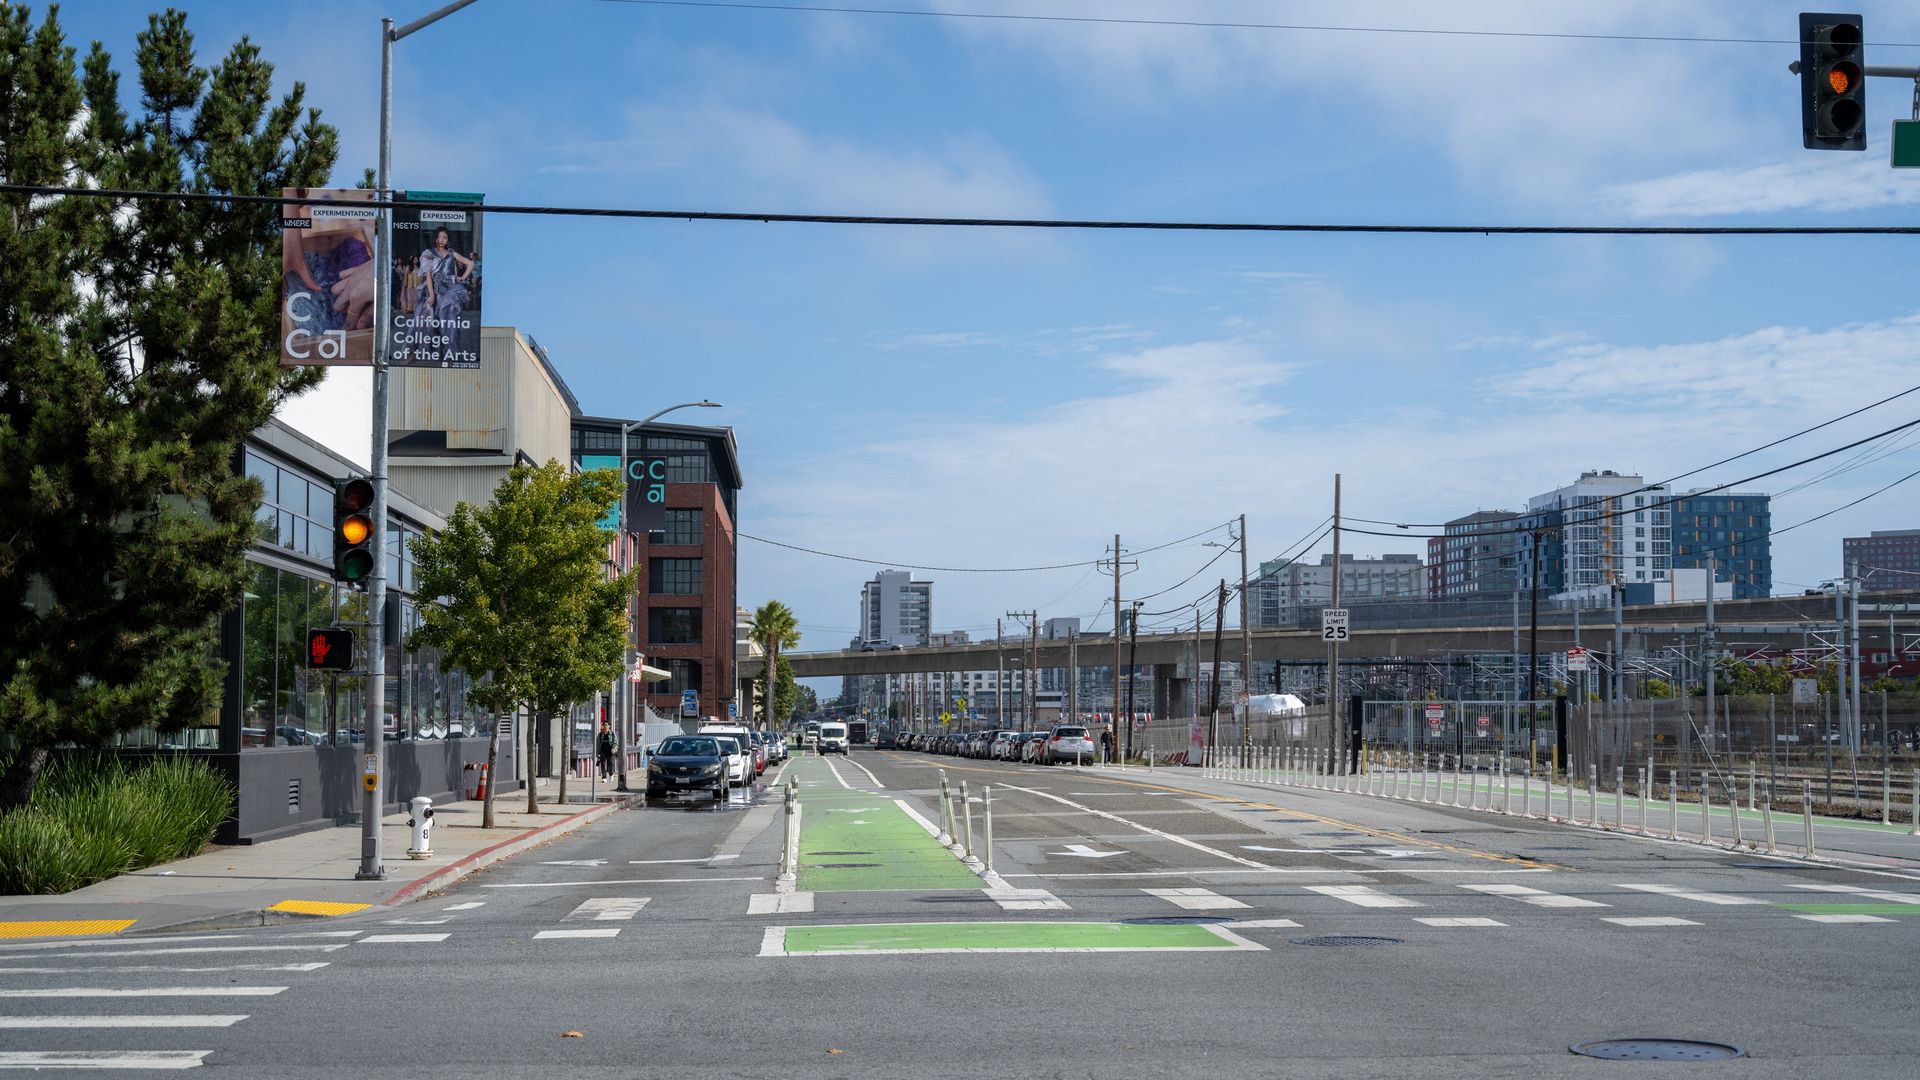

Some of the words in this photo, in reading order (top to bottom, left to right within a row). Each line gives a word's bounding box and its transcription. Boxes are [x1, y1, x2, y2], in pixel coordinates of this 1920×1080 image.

[313, 209, 374, 217] EXPERIMENTATION
[422, 212, 465, 220] EXPRESSION
[284, 219, 311, 227] WHERE
[393, 222, 419, 230] MEETS
[394, 315, 471, 329] California
[393, 331, 450, 348] College
[393, 347, 411, 360] of
[413, 348, 440, 361] the
[443, 348, 477, 362] Arts
[1325, 626, 1347, 639] 25
[423, 829, 428, 839] 8
